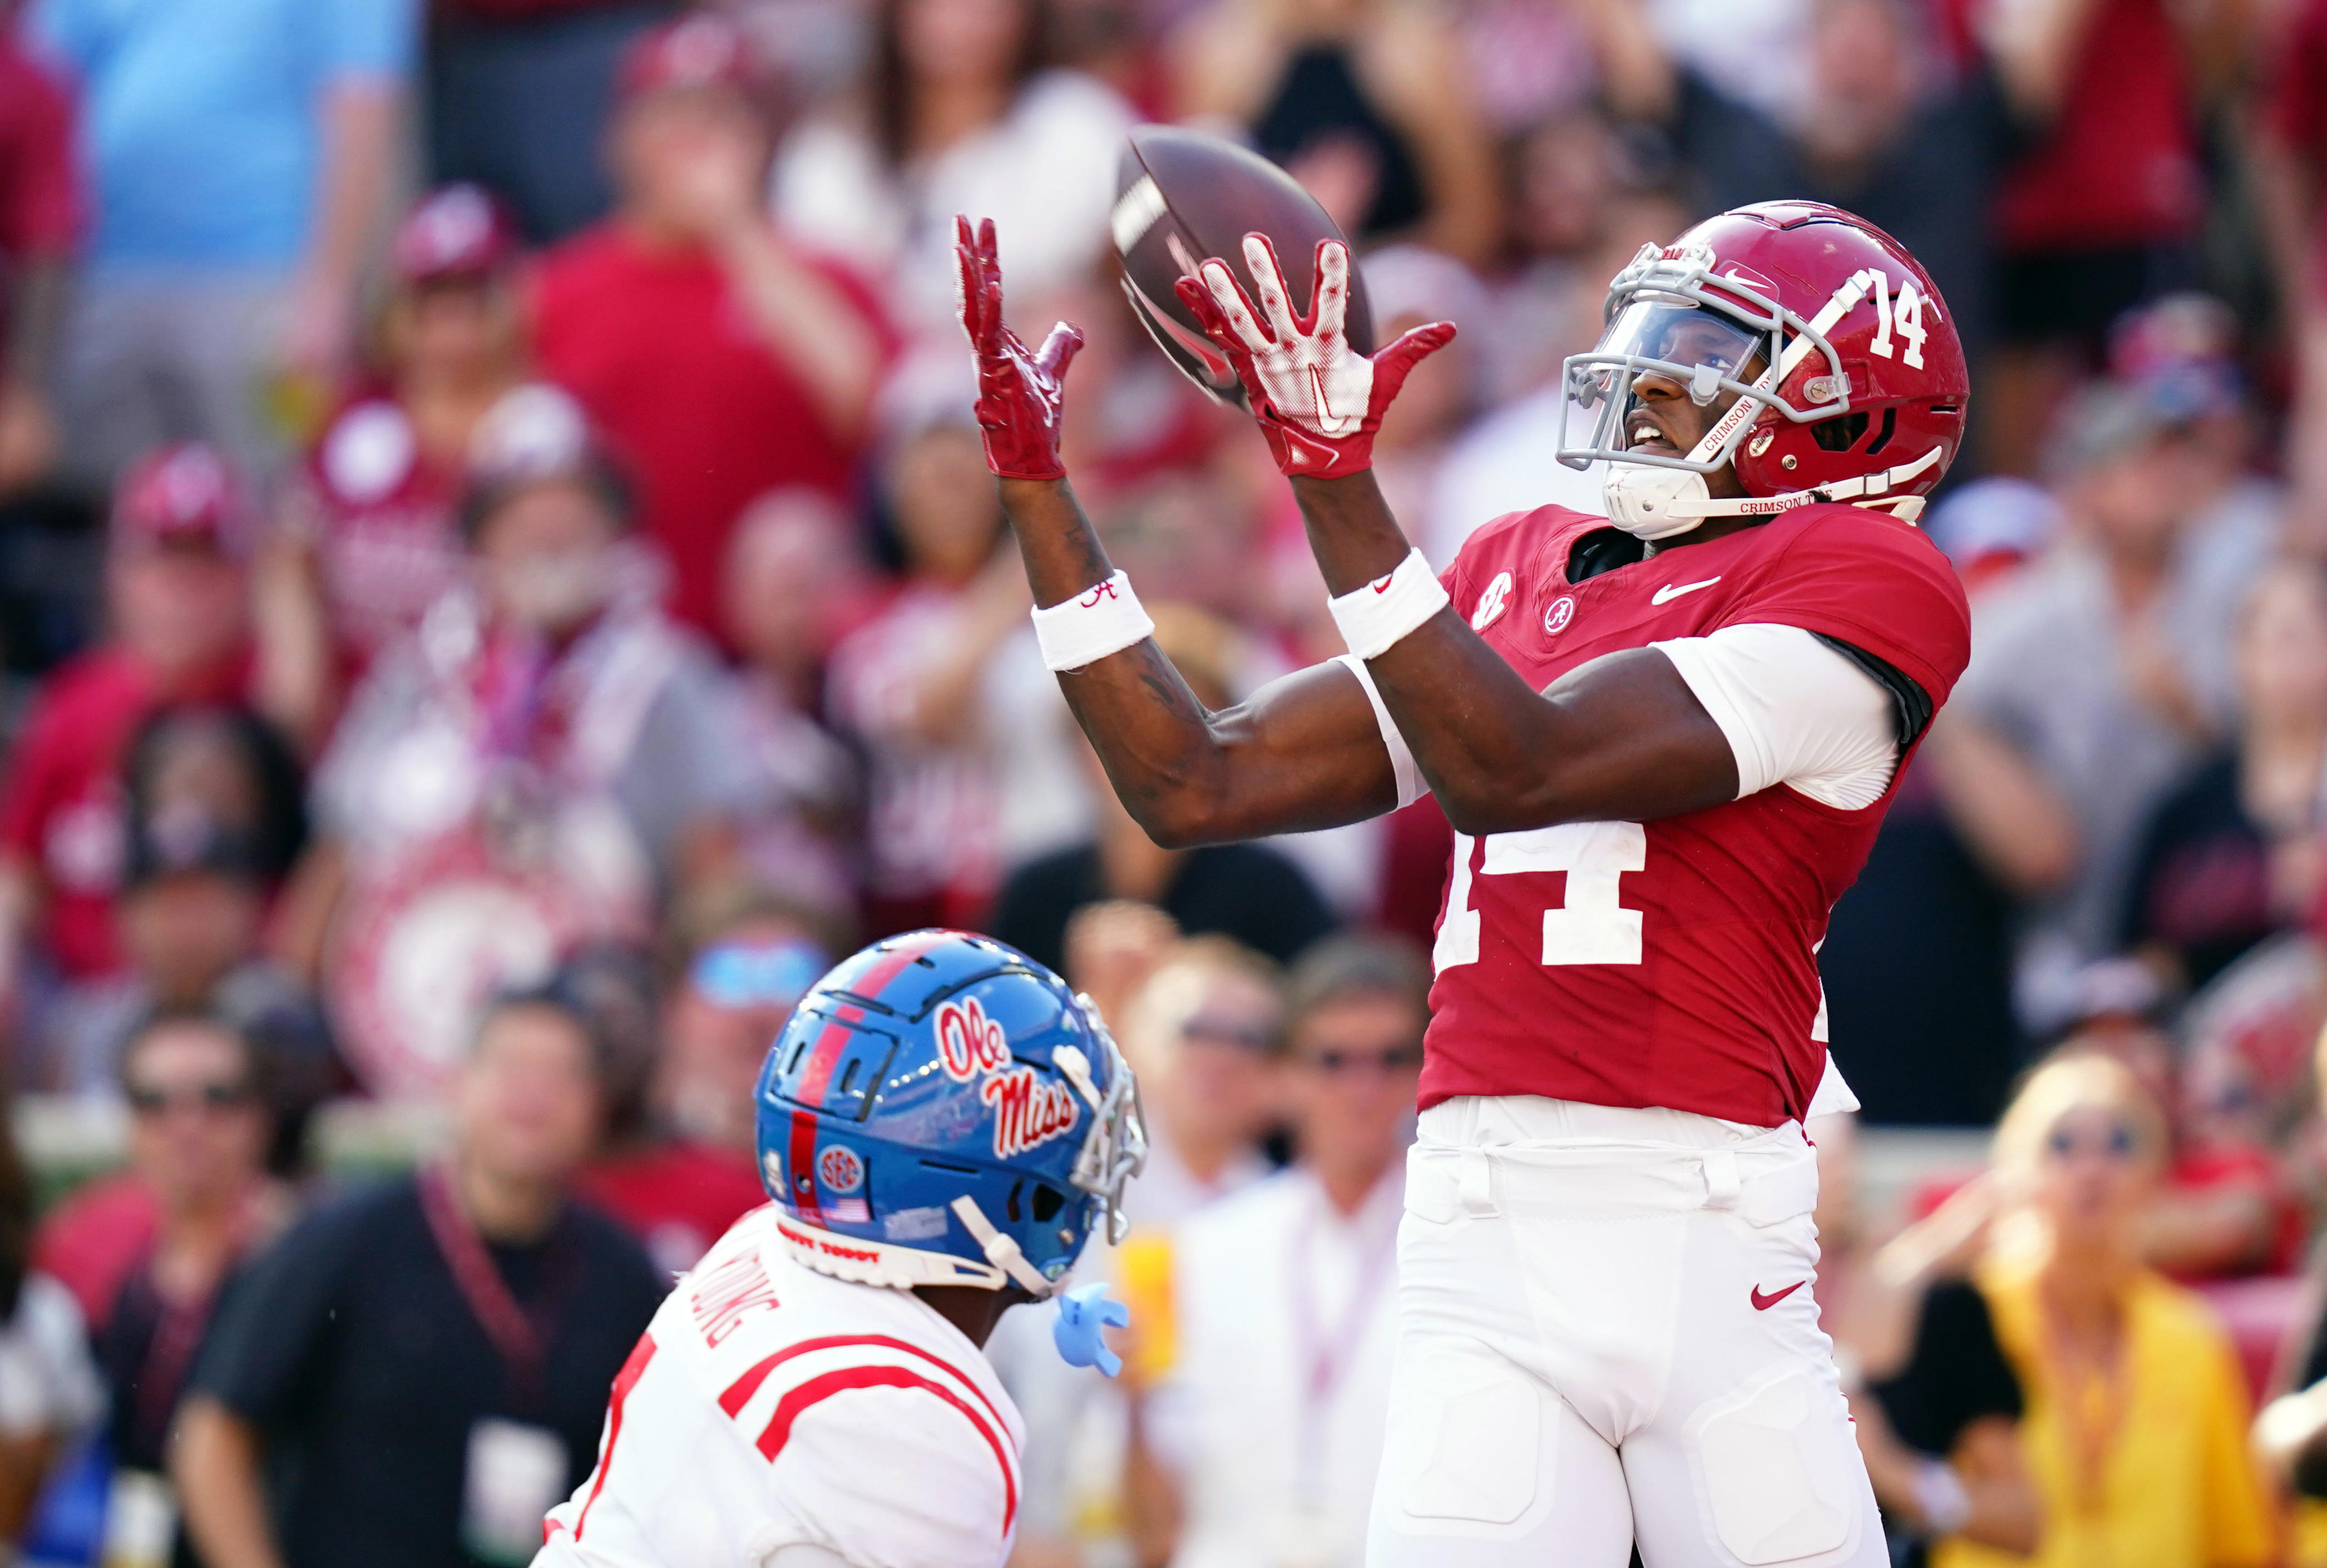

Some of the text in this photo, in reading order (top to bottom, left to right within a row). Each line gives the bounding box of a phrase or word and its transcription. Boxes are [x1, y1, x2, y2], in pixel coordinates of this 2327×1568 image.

[1868, 267, 1928, 370] 14
[1704, 399, 1753, 452] CRIMSON
[1740, 489, 1832, 513] CRIMSON TE
[1472, 571, 1512, 631] SEC
[936, 997, 1009, 1080] Ole
[982, 1069, 1076, 1156] Miss
[821, 1148, 858, 1190] SEC
[819, 1241, 880, 1264] TODDY
